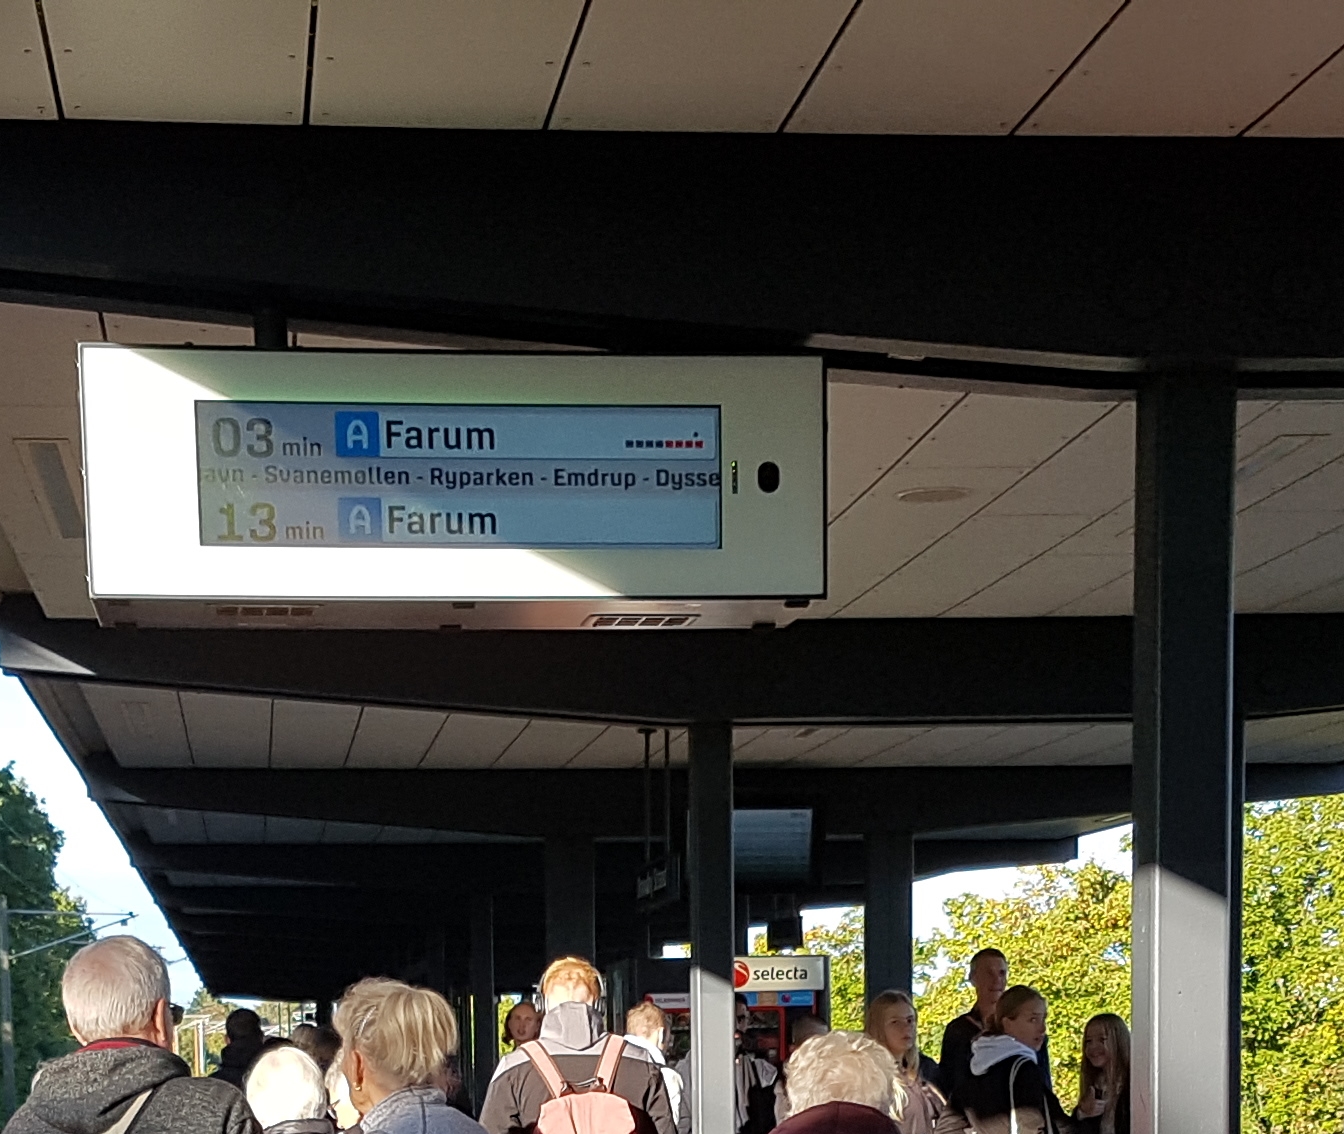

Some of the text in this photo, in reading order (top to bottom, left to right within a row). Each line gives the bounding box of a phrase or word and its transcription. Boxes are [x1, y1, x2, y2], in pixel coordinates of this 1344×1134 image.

[211, 417, 496, 458] 03 min A Farum
[430, 467, 534, 490] Ryparken
[553, 468, 636, 491] Emdrup
[217, 502, 498, 543] 13 min A Farum
[752, 967, 808, 981] selecta
